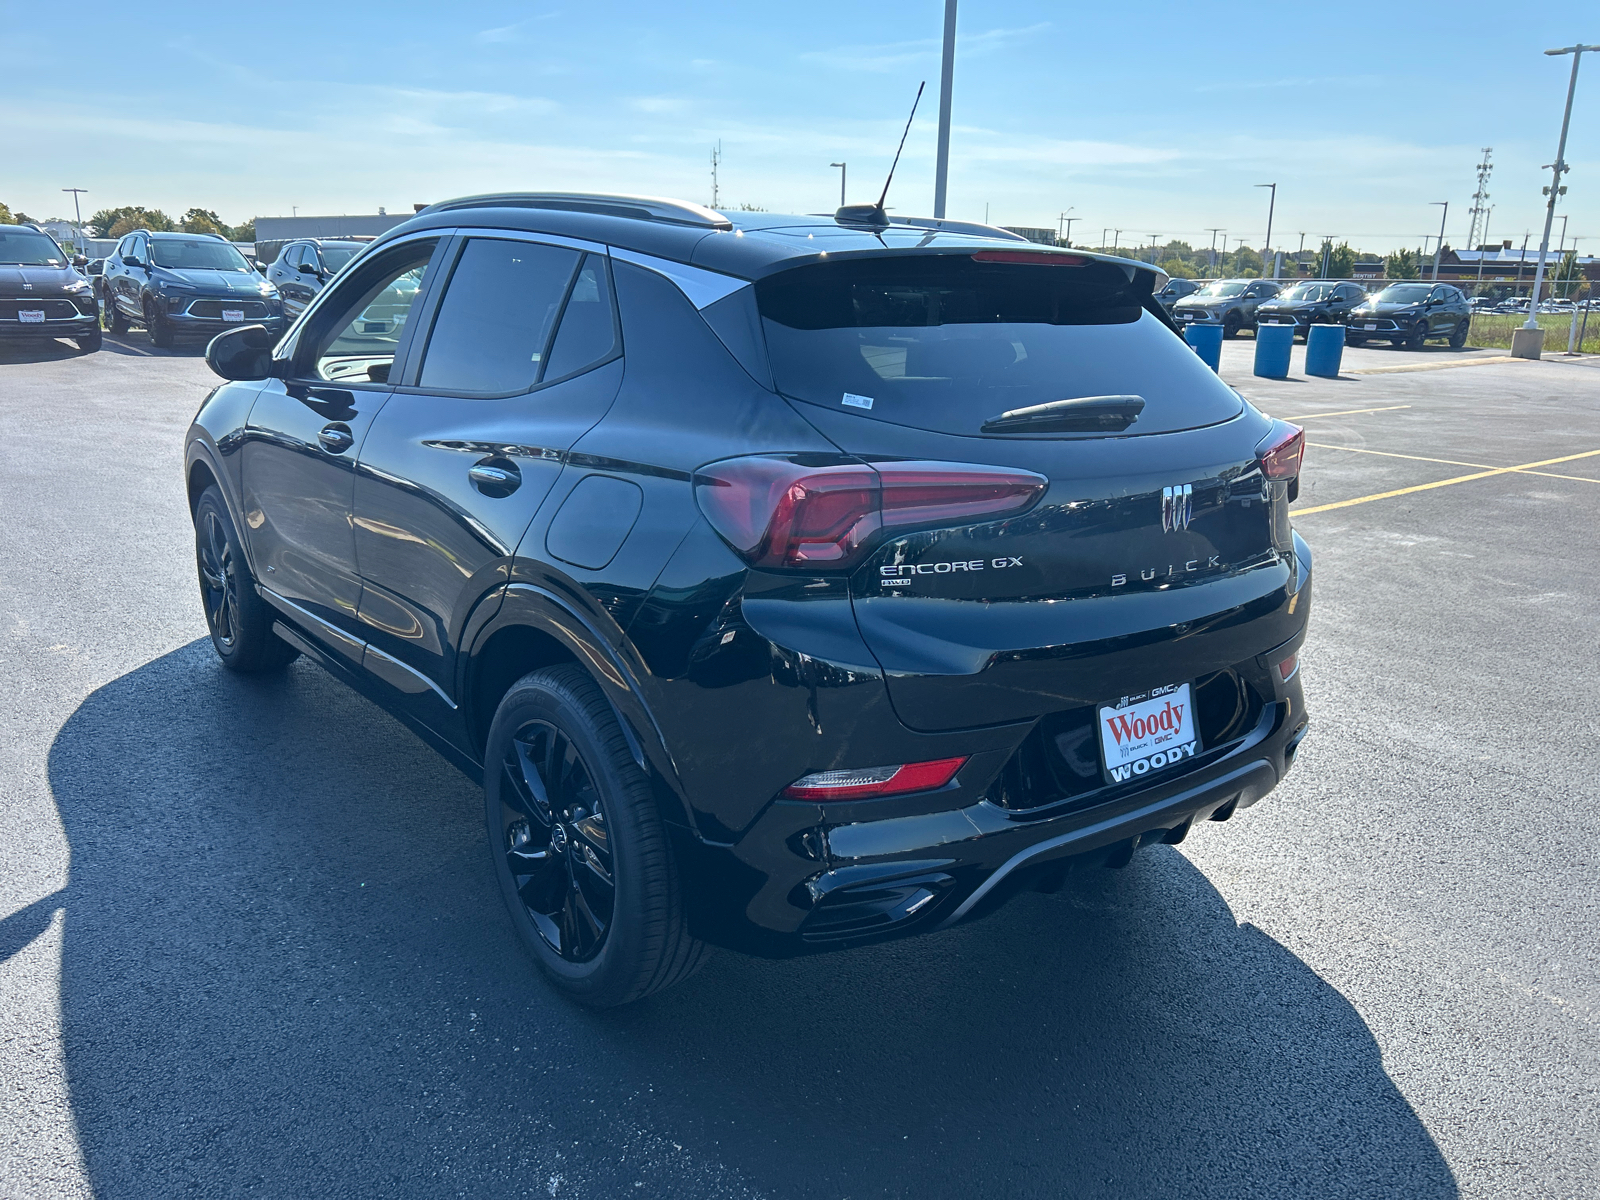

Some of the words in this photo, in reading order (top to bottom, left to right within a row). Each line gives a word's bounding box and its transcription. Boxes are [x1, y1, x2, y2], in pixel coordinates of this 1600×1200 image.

[879, 559, 985, 577] ENCORE
[991, 555, 1024, 569] GX
[1111, 555, 1220, 587] BUICK
[881, 578, 911, 587] AWD
[1130, 693, 1147, 702] BUICK
[1152, 683, 1175, 697] GMC
[1106, 701, 1185, 746] Woody
[1130, 742, 1148, 752] BUICK
[1154, 733, 1173, 745] GMC
[1110, 740, 1198, 783] WOODY
